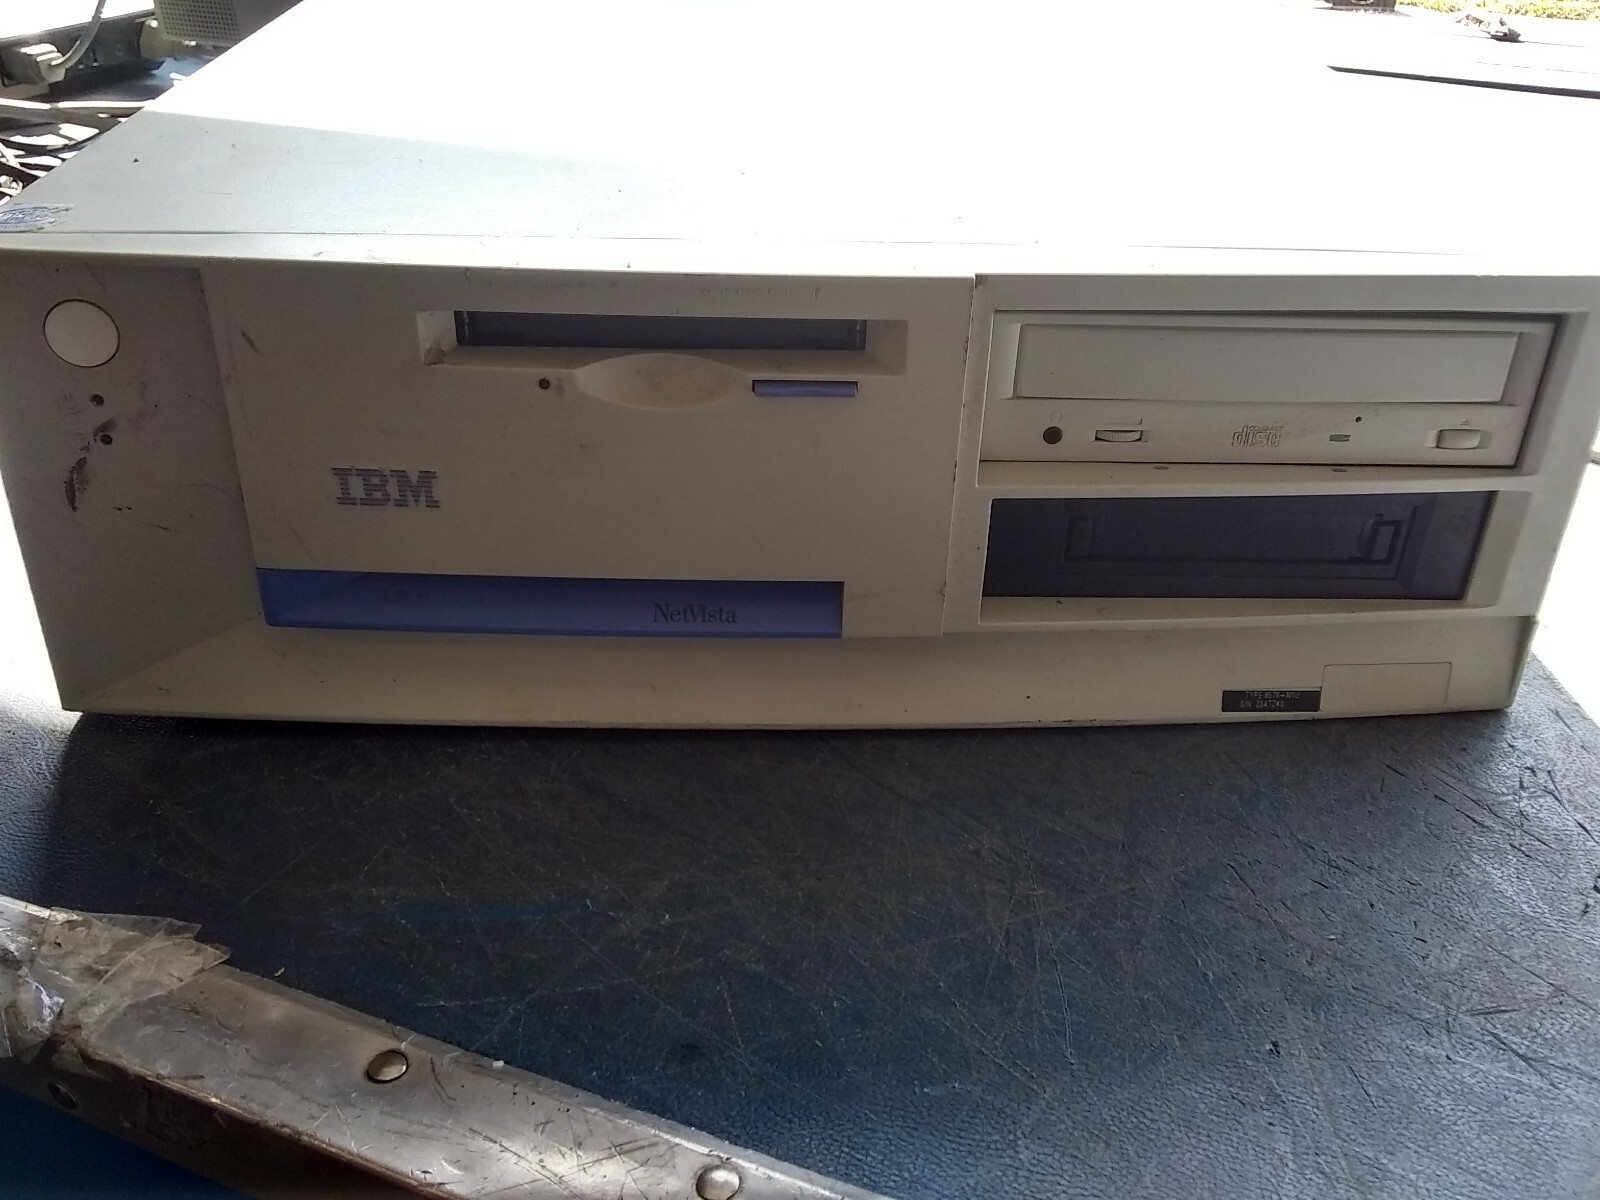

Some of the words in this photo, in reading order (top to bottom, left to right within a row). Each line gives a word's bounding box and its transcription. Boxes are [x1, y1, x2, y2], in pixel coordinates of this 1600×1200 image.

[331, 467, 440, 508] IBM
[652, 602, 738, 624] NetVista
[1246, 691, 1263, 699] TYPE
